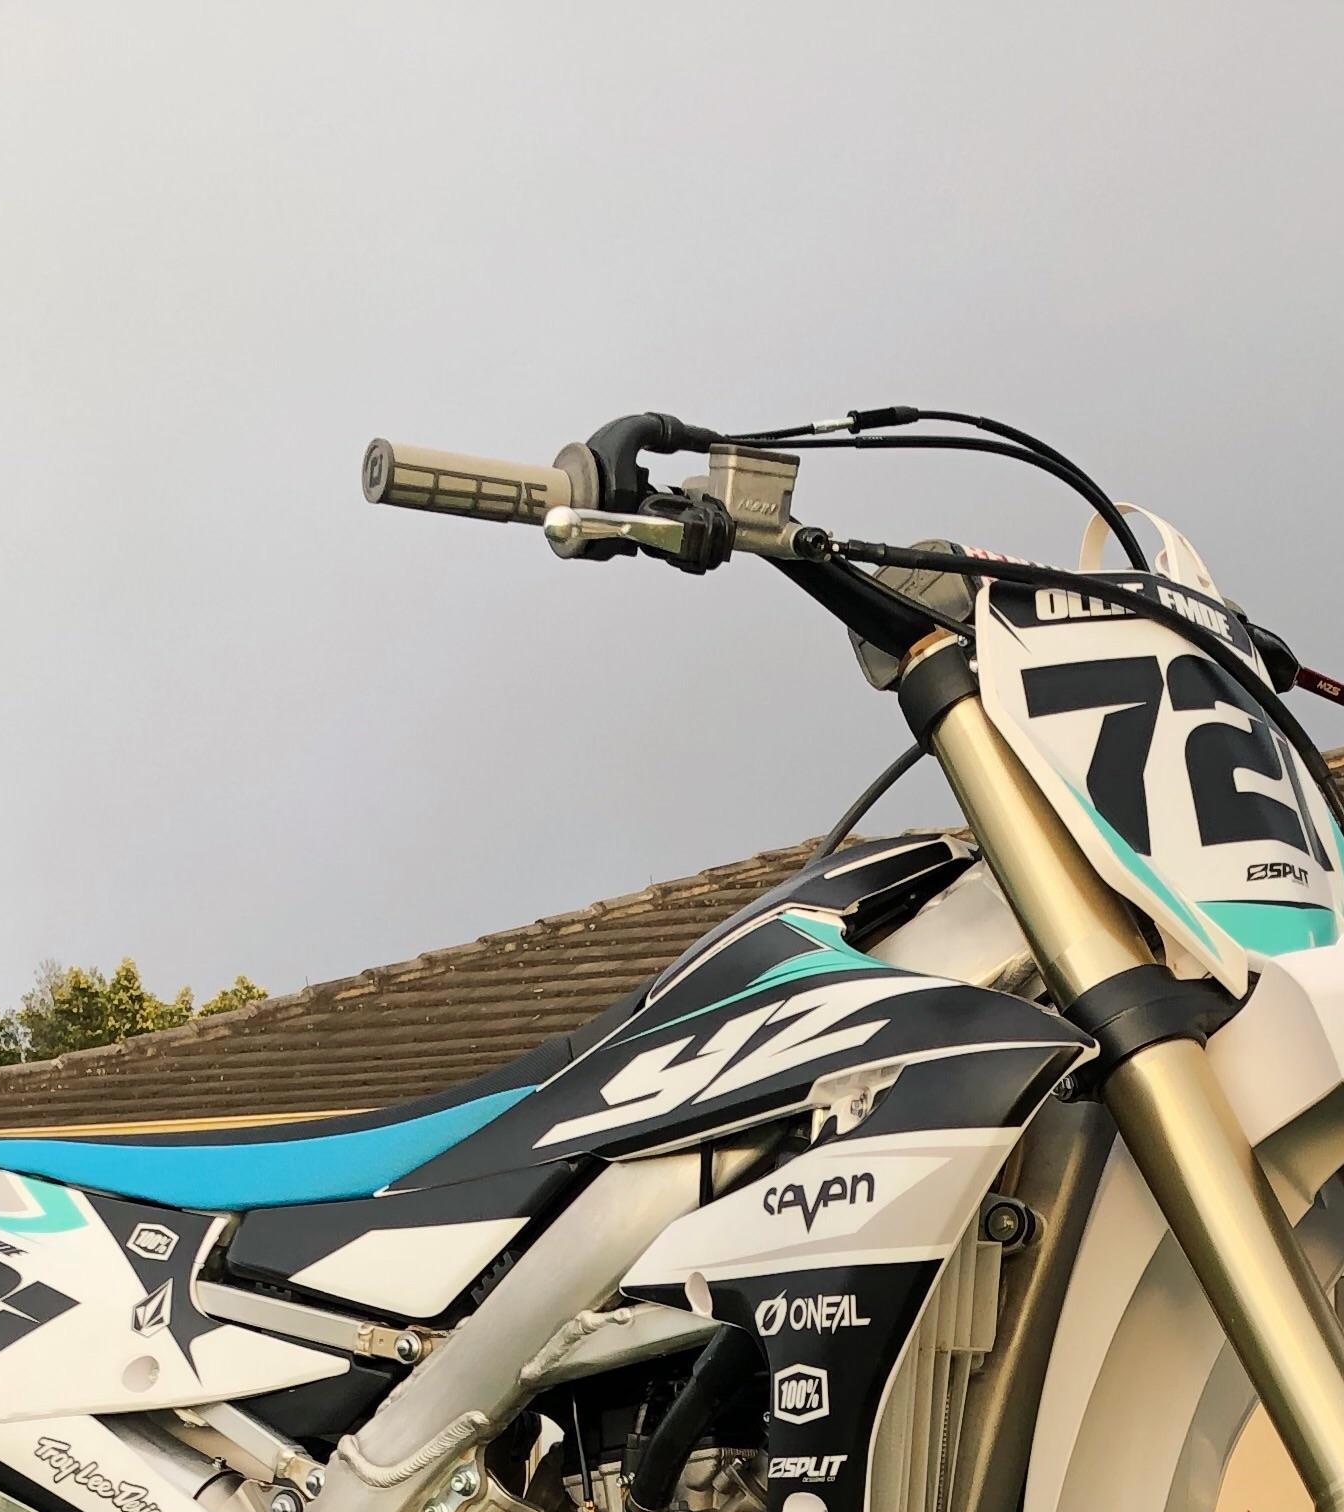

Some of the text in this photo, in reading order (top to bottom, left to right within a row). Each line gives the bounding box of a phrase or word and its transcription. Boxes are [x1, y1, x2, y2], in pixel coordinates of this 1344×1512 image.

[1268, 862, 1309, 885] SPLIT
[531, 976, 969, 1150] YZ
[134, 1230, 173, 1254] 100%
[780, 1378, 820, 1410] 100%
[34, 1436, 81, 1484] Troy
[73, 1461, 116, 1499] Lee
[783, 1454, 849, 1478] SPLIT
